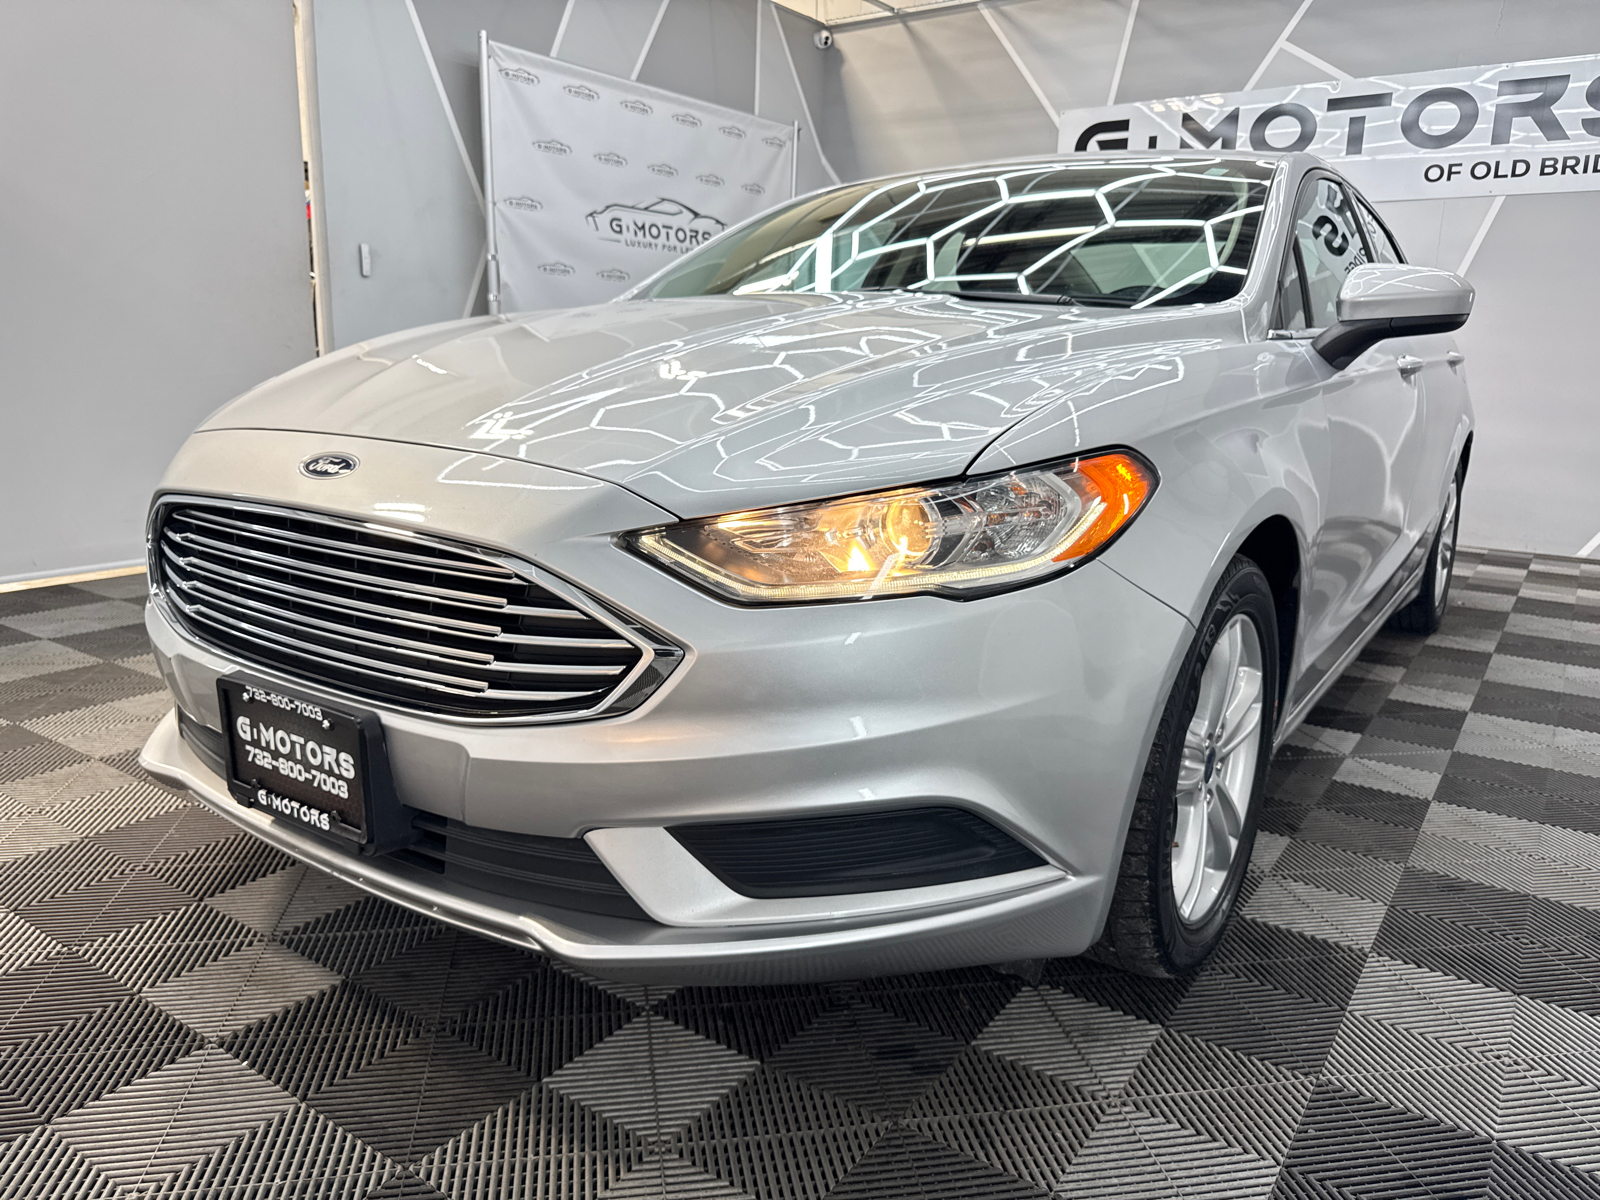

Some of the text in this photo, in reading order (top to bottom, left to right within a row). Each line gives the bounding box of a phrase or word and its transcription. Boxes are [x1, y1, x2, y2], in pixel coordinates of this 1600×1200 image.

[1424, 163, 1463, 183] OF
[1470, 159, 1531, 180] OLD
[308, 456, 346, 473] Ford
[245, 685, 323, 721] 732-800-7003
[245, 744, 349, 800] 732-800-7003
